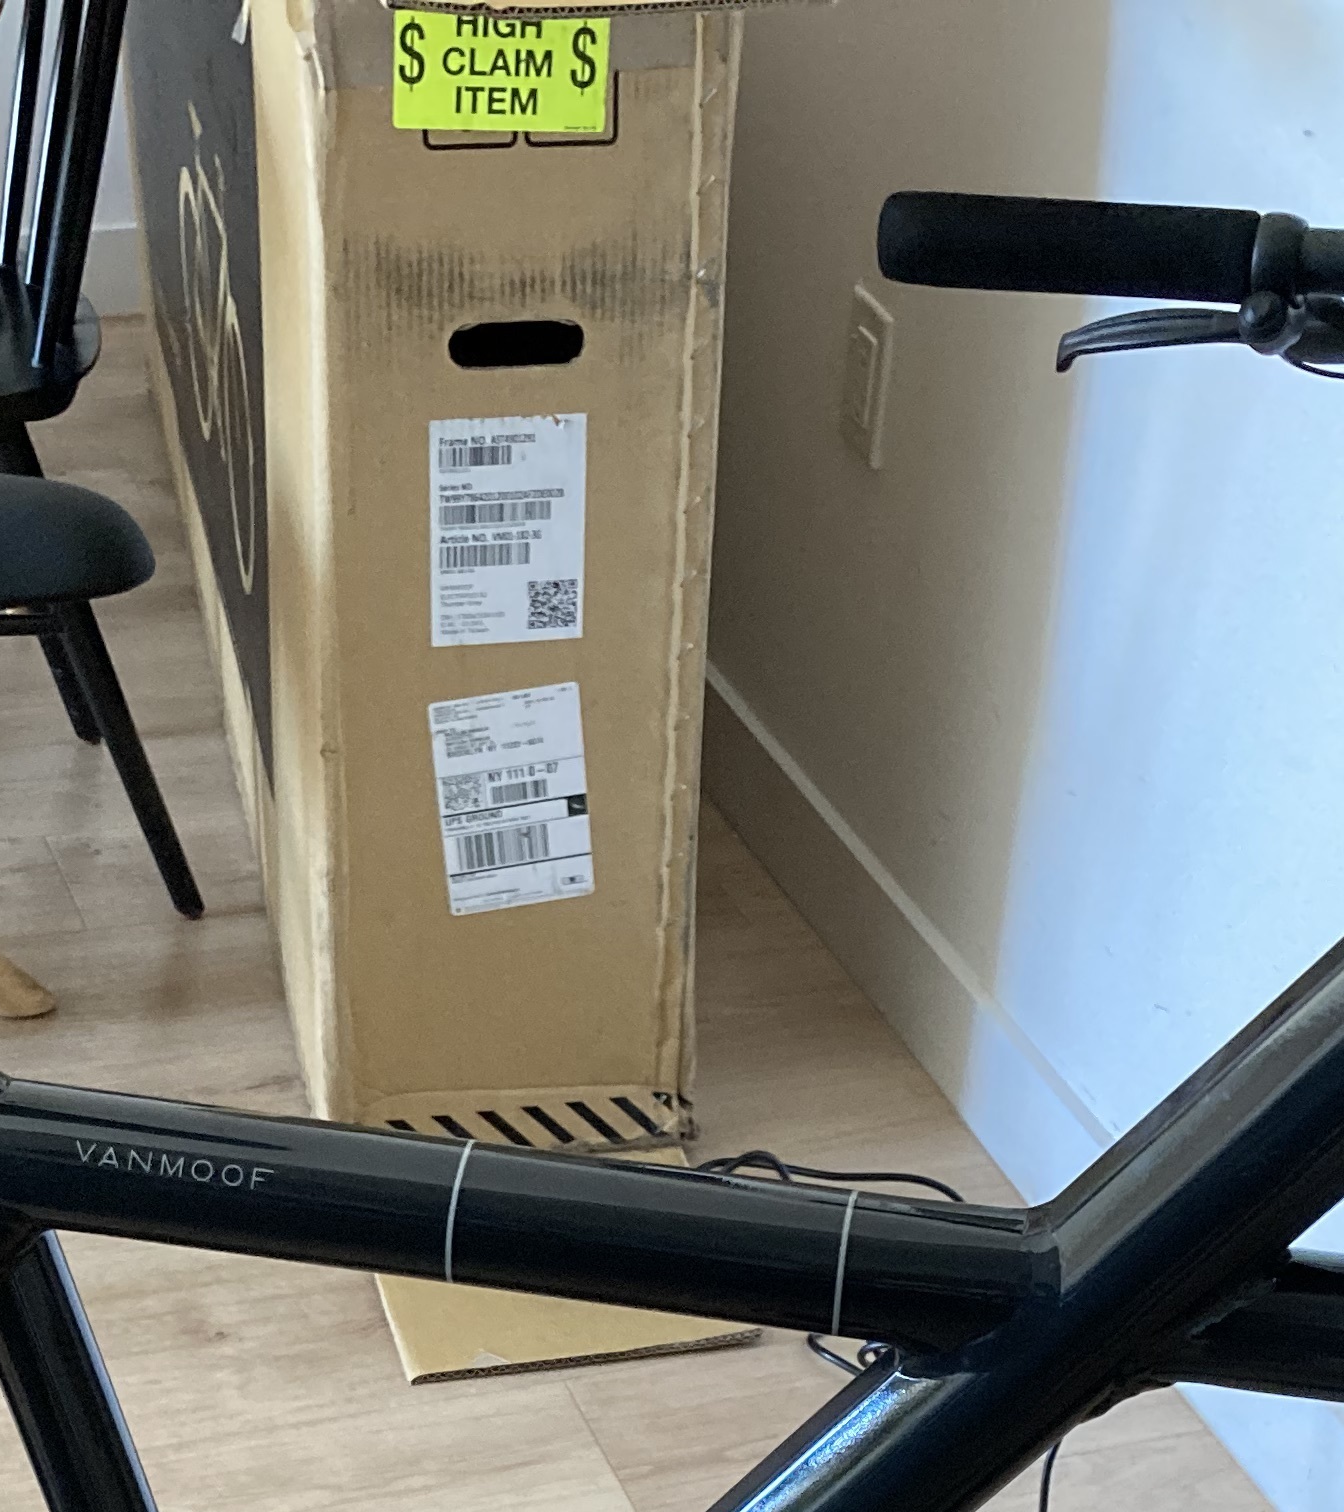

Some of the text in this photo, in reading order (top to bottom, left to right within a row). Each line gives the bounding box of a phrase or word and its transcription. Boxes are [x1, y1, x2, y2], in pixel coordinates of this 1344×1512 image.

[456, 16, 542, 39] HIGH
[442, 47, 553, 77] CLAIM
[455, 86, 538, 115] ITEM
[76, 1140, 275, 1190] VANMOOF
